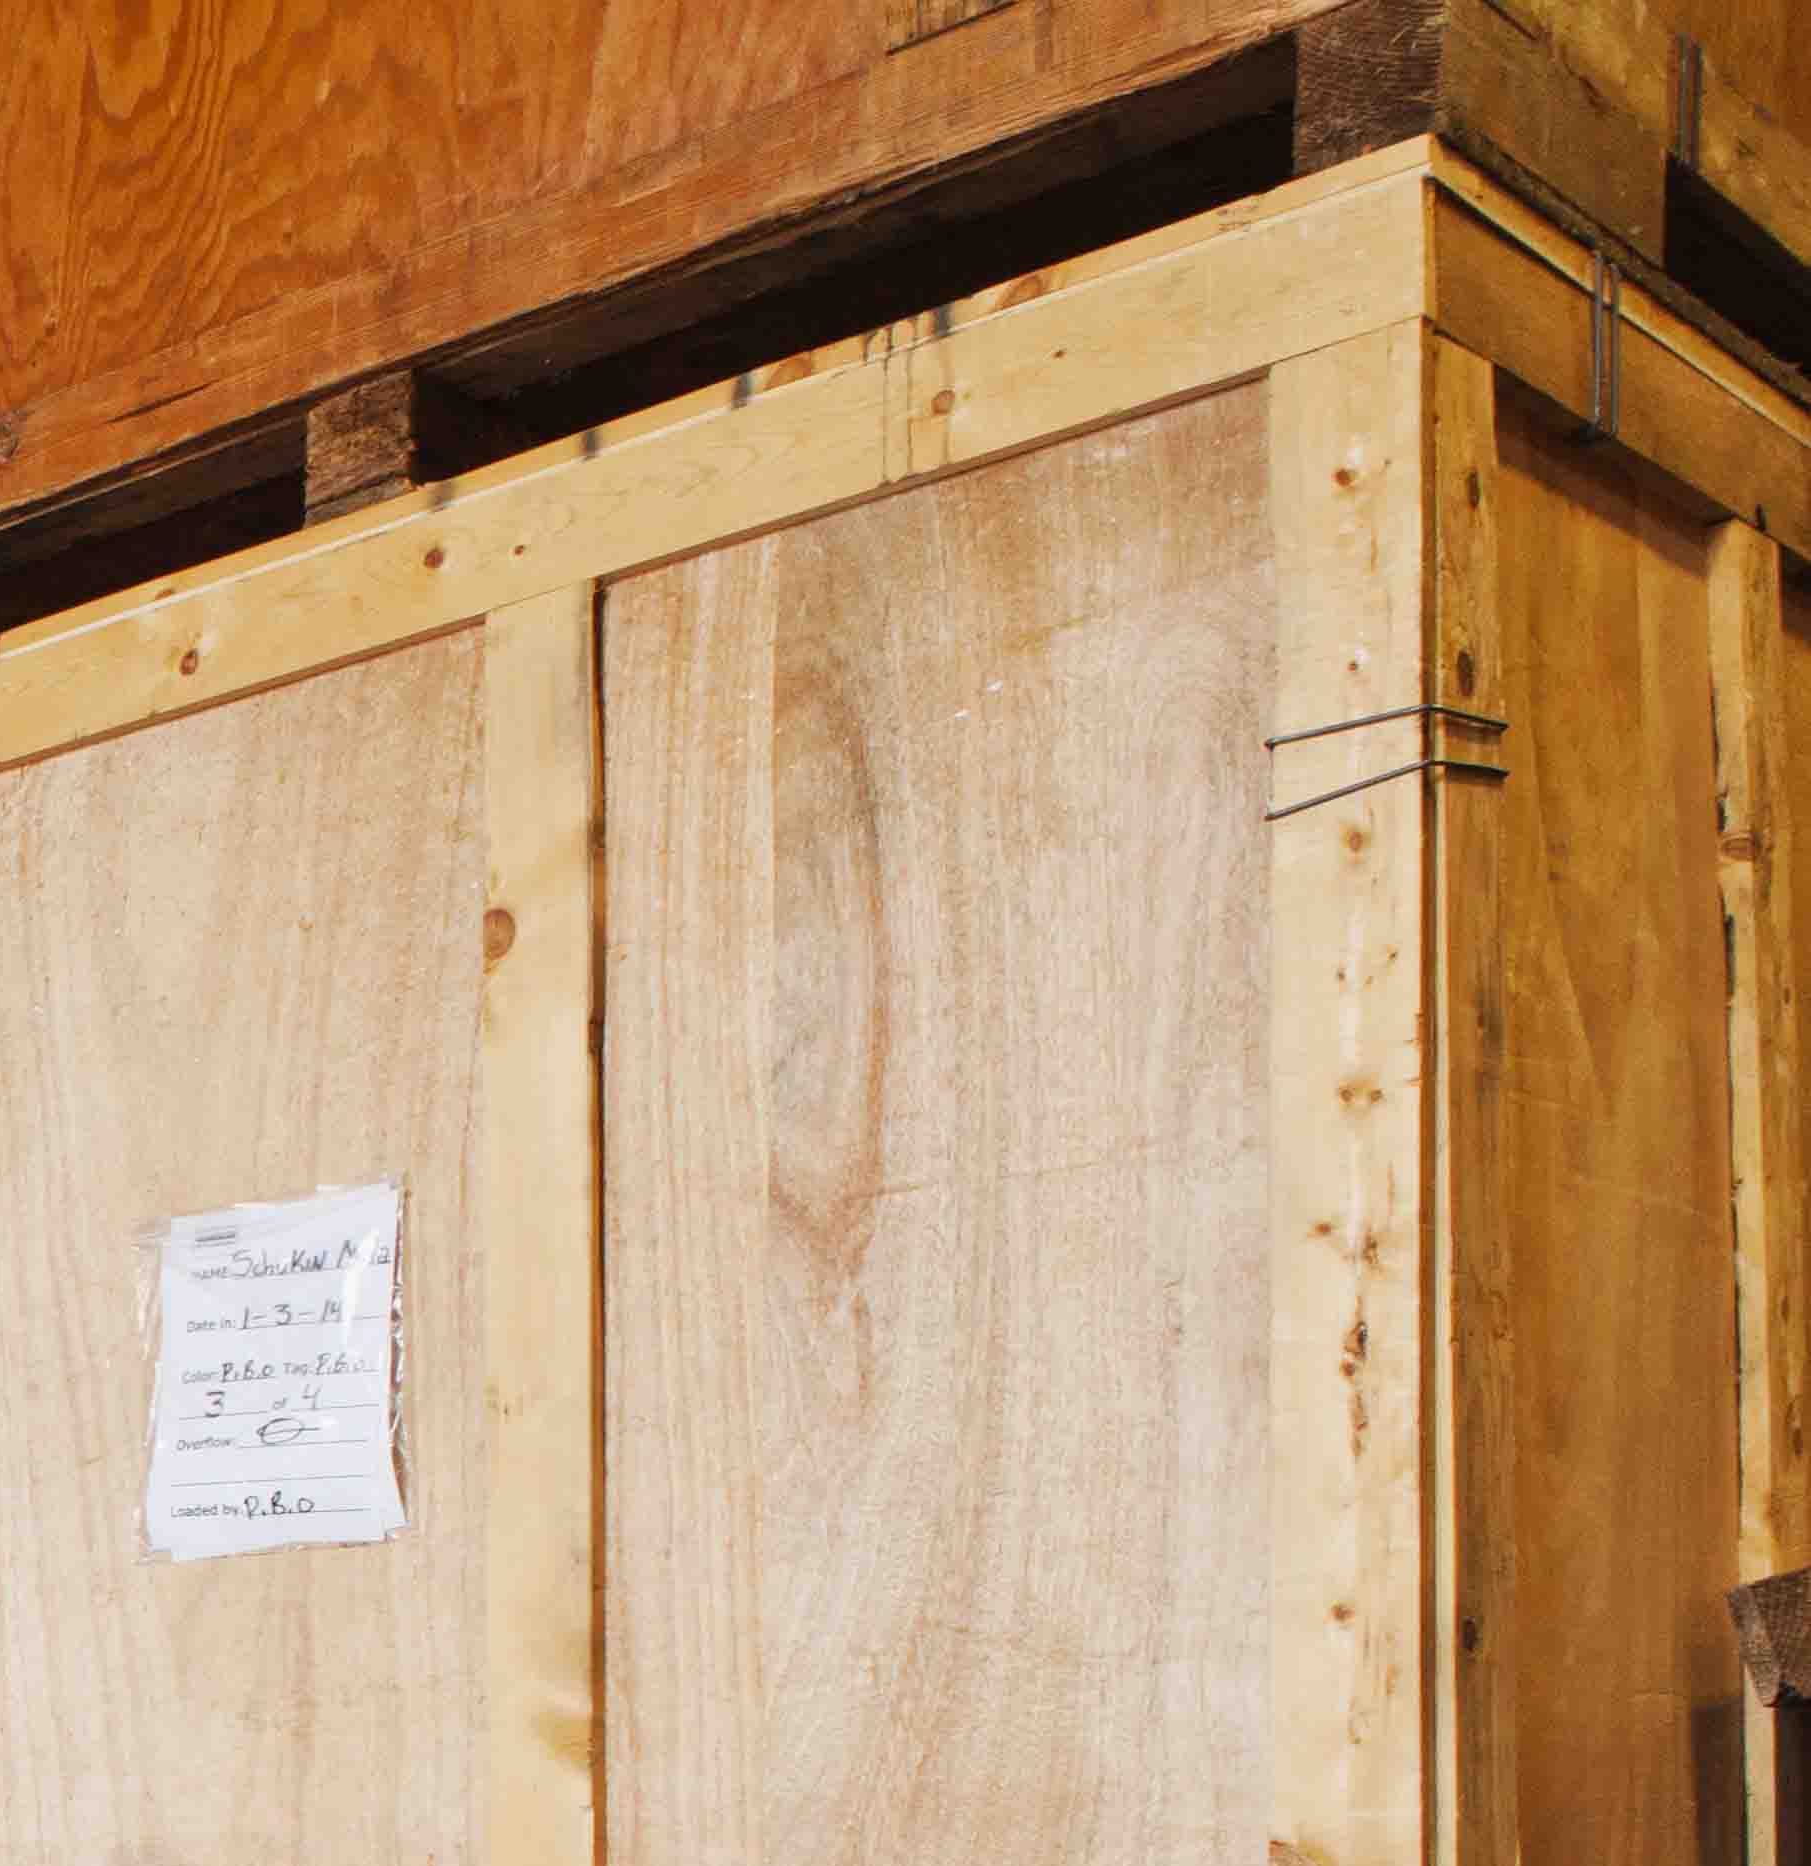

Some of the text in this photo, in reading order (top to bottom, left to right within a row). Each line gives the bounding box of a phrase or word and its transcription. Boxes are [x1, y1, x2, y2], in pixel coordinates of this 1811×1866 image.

[205, 1383, 321, 1418] 3 of 4
[170, 1503, 219, 1519] Loaded
